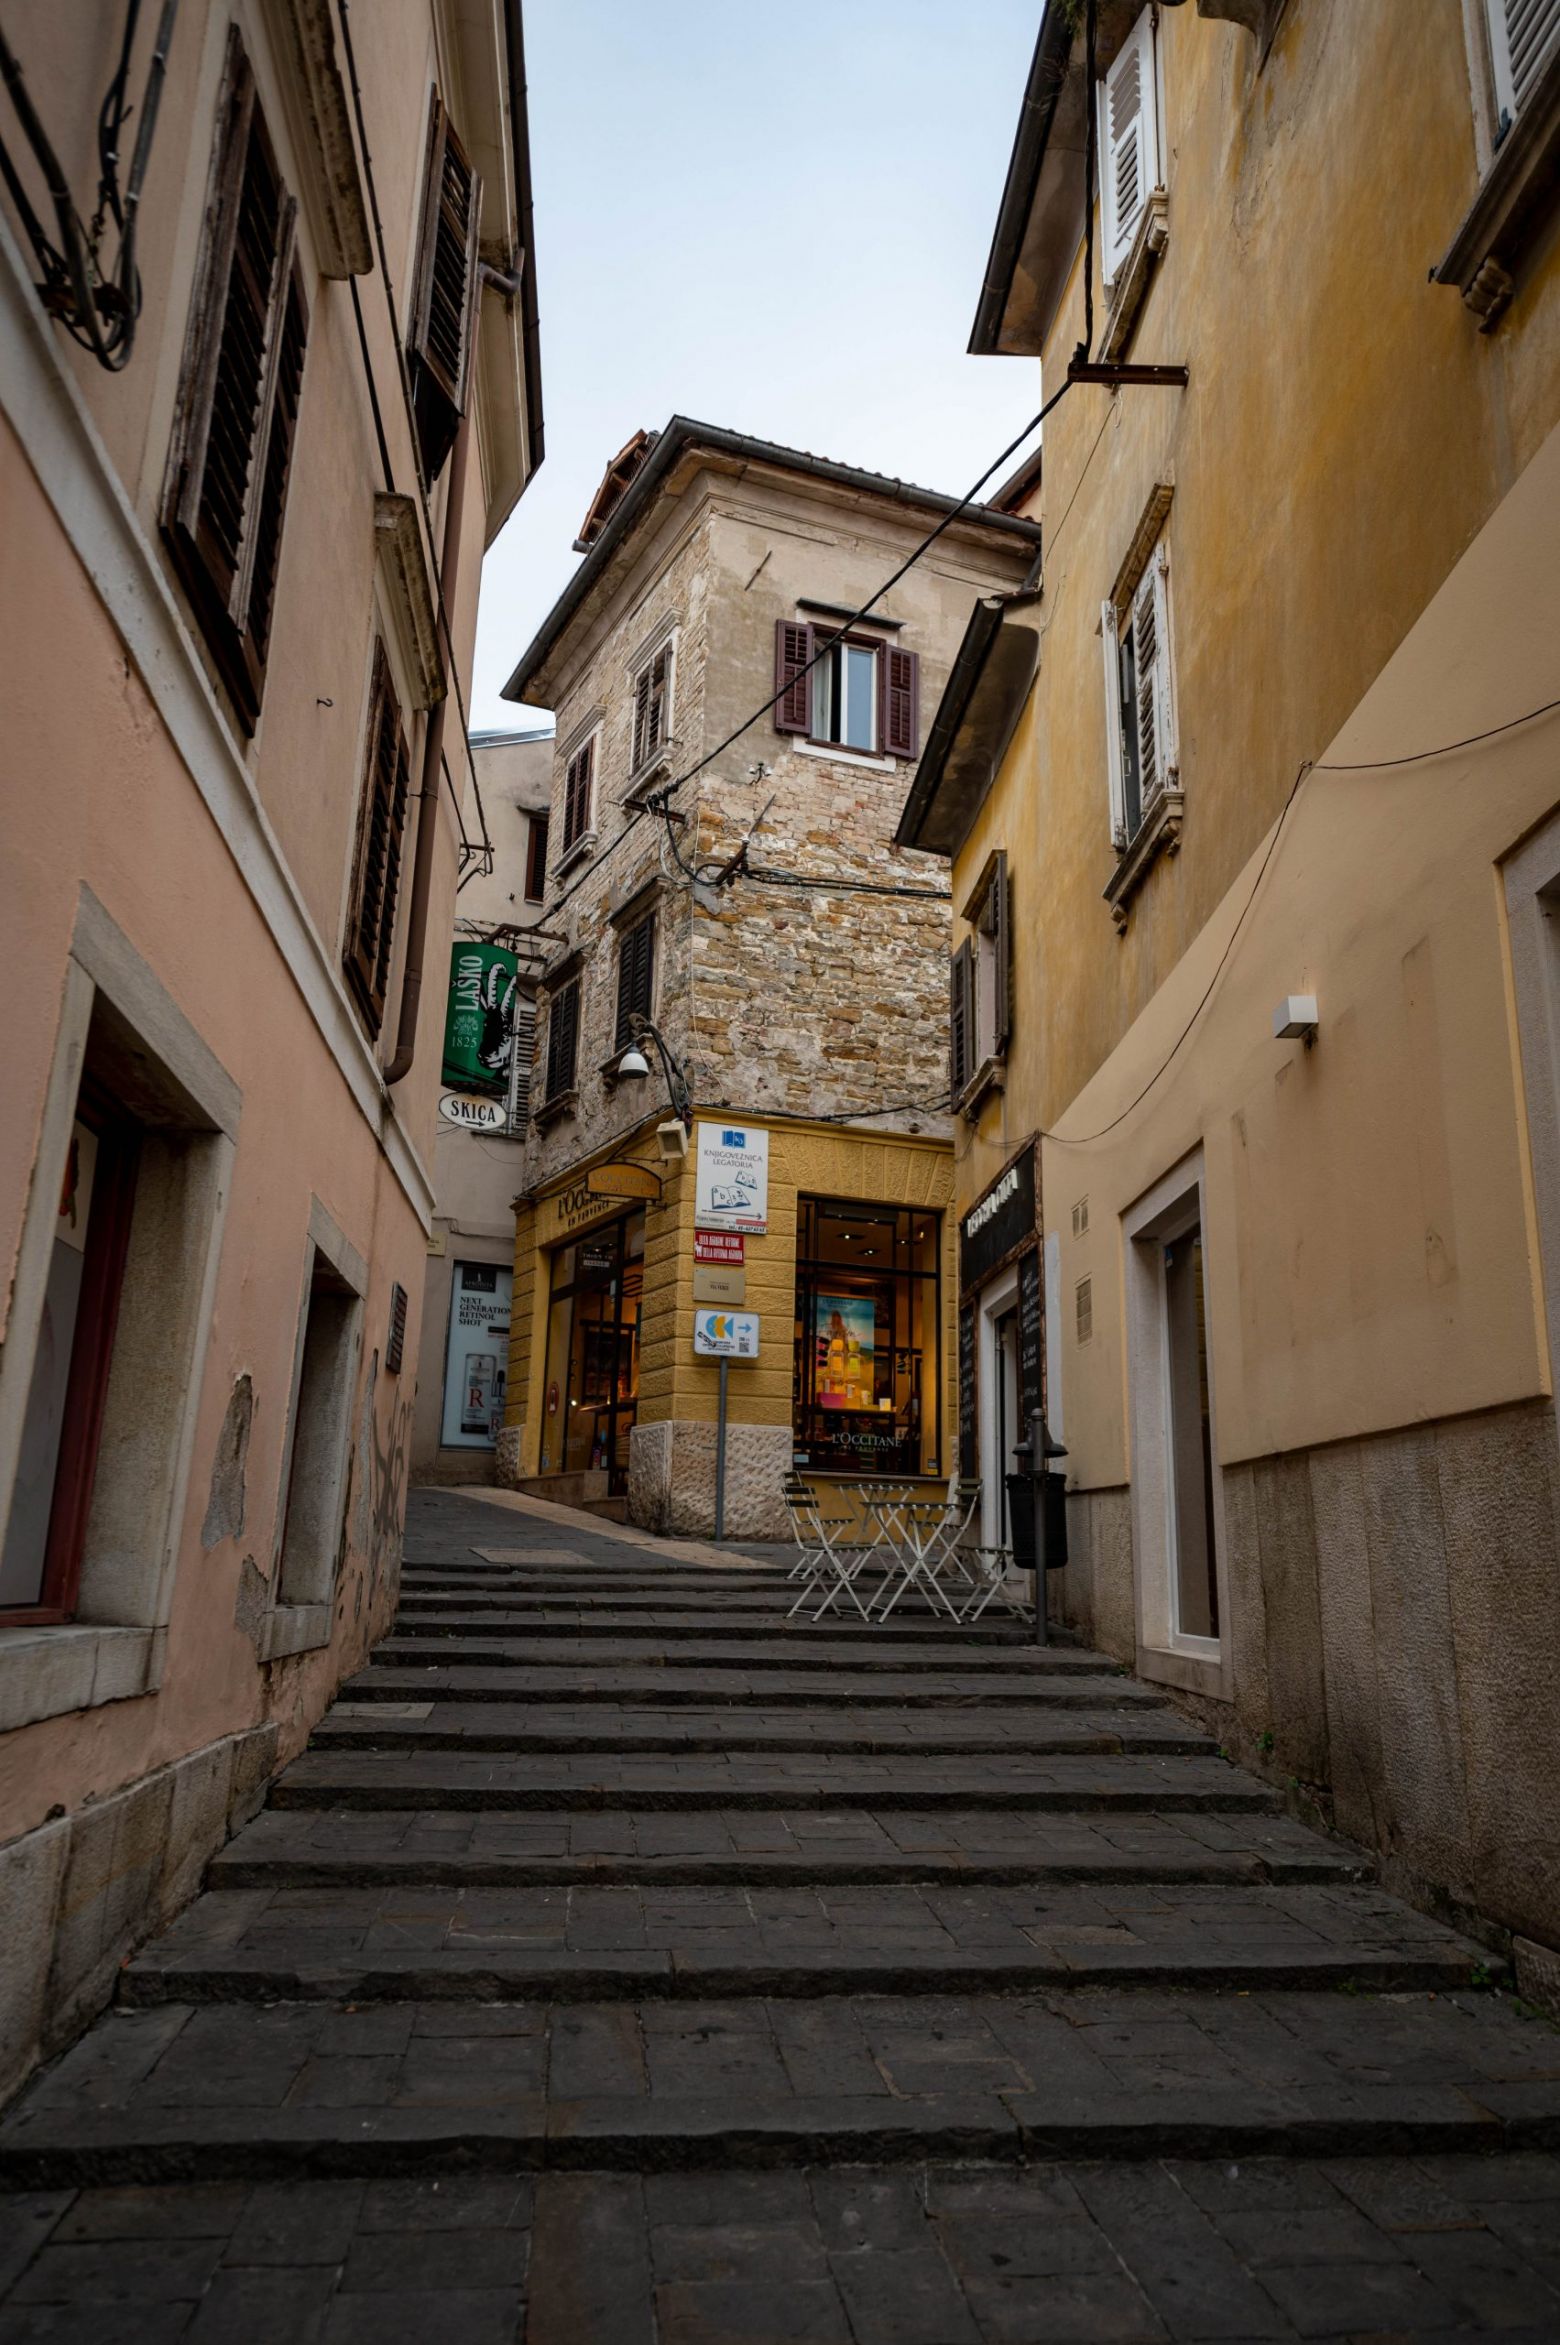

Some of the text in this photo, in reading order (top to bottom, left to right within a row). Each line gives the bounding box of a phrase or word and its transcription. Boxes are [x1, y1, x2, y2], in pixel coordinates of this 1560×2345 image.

[452, 955, 483, 1011] LAŠKO
[452, 1036, 478, 1048] 1825
[451, 1100, 497, 1123] SKICA
[713, 1159, 753, 1169] LEGATORIA
[460, 1297, 482, 1305] NEXT
[460, 1304, 511, 1314] GENERATION
[459, 1311, 496, 1320] RETINOL
[459, 1319, 482, 1327] SHOT
[469, 1388, 484, 1408] R
[832, 1432, 902, 1448] L'OCCITANE
